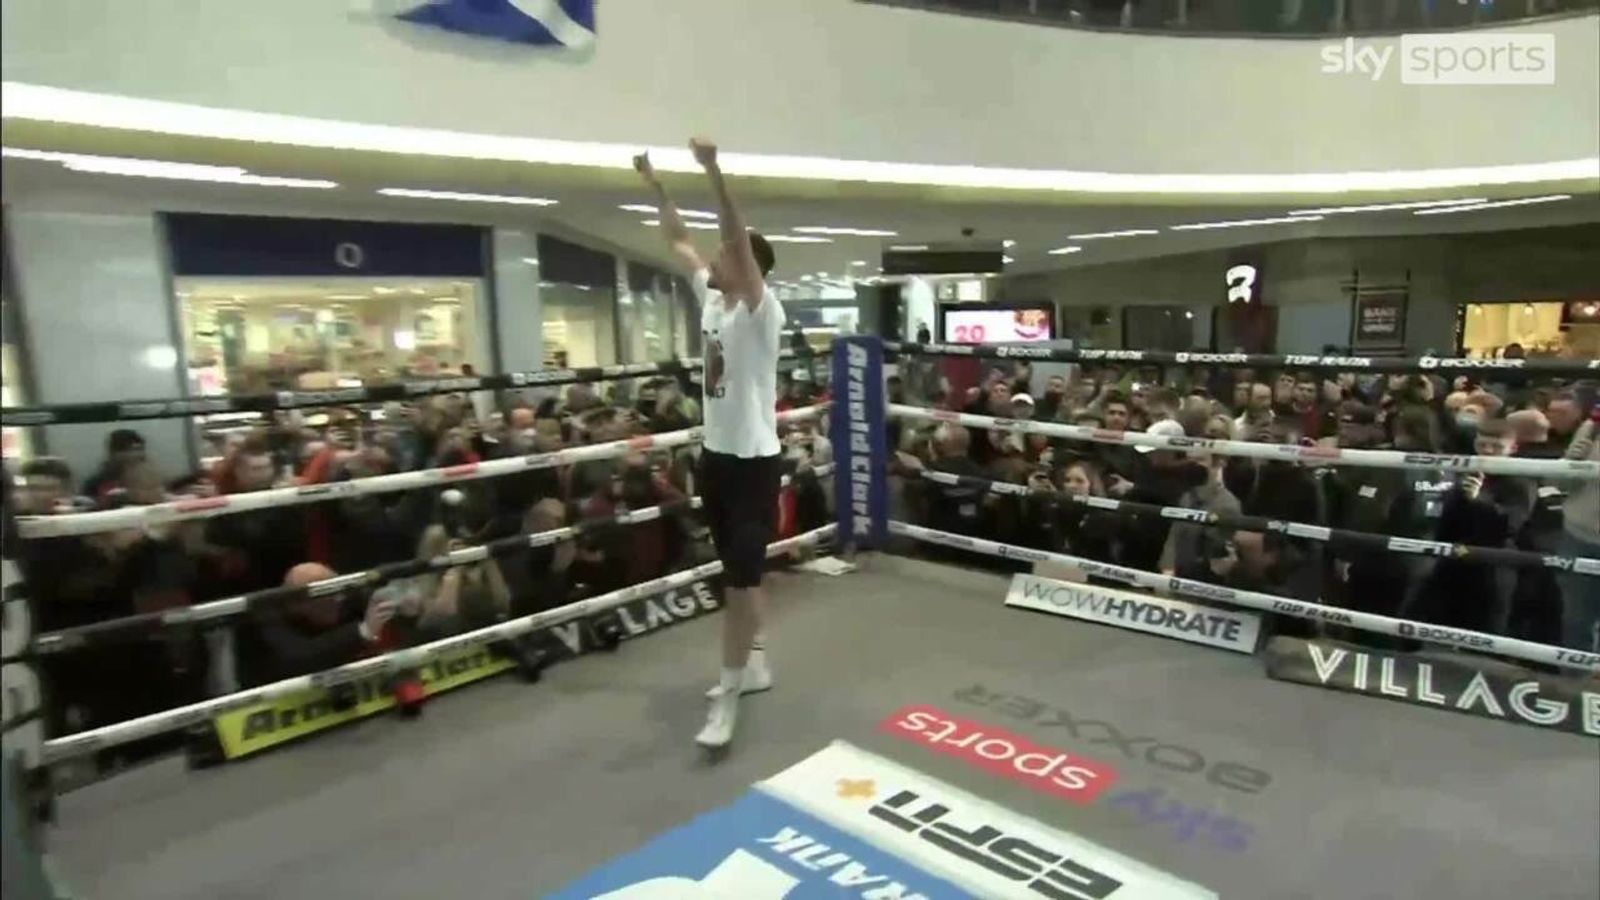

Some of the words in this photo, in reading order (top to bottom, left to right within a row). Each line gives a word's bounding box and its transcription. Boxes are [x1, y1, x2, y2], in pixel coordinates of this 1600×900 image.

[1418, 627, 1495, 649] BOXXER
[1307, 643, 1600, 735] VILLAGE
[898, 711, 1099, 790] sports
